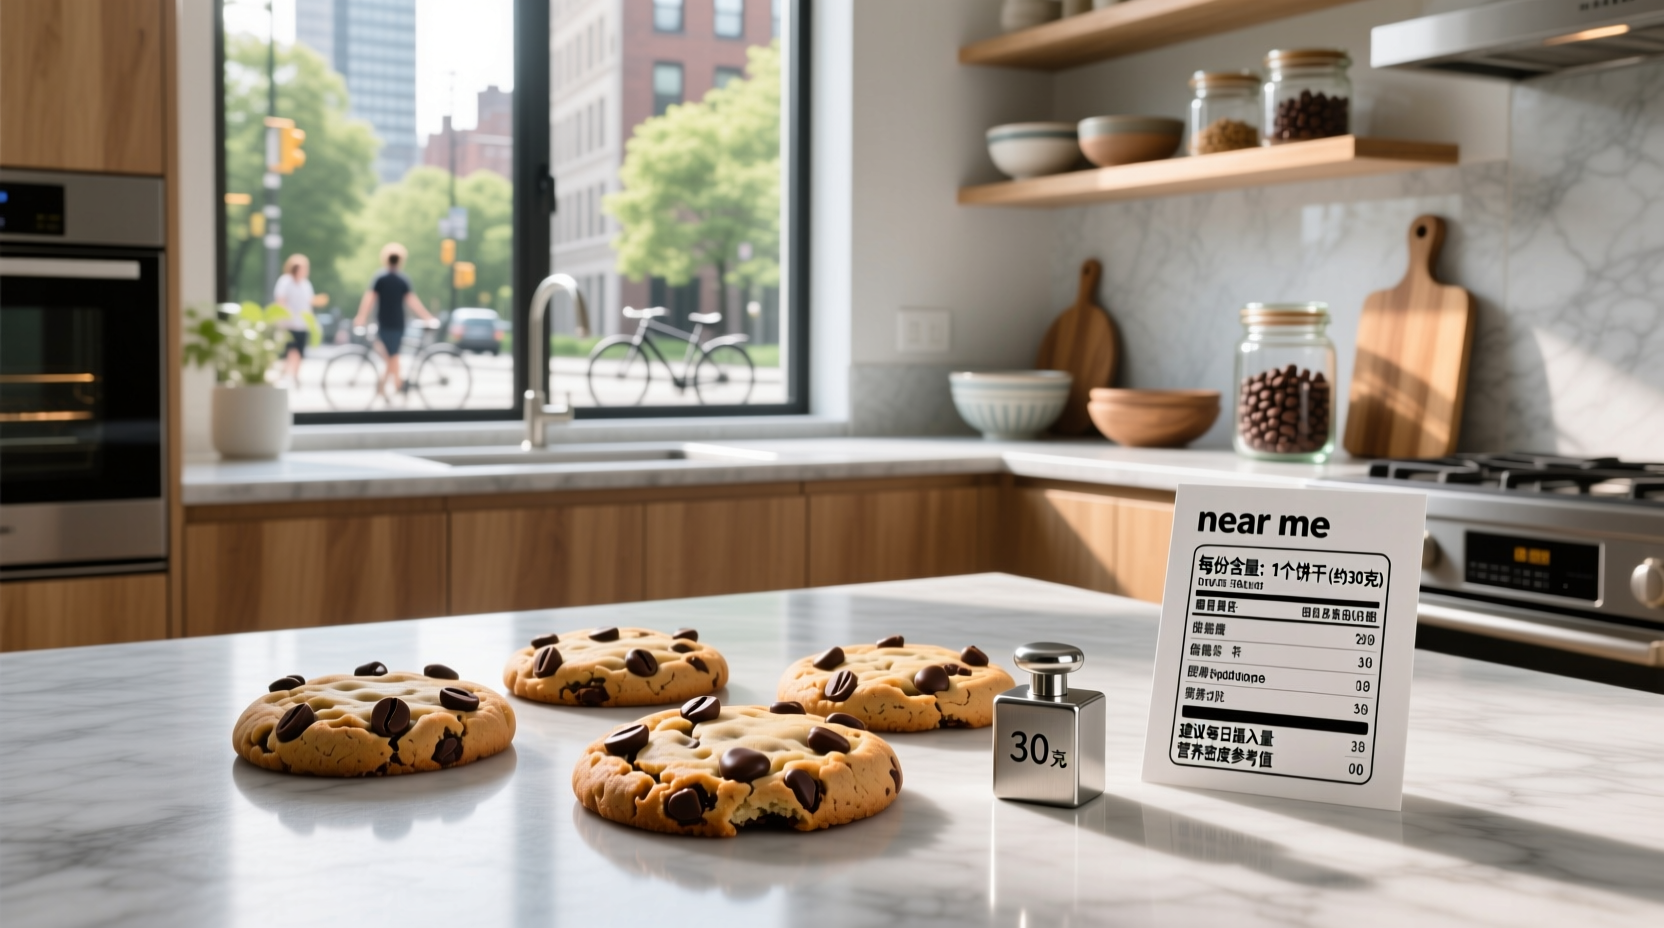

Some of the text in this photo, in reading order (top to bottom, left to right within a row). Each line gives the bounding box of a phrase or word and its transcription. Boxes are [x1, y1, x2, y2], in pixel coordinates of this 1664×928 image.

[1197, 510, 1331, 538] near me
[1010, 731, 1068, 769] 30克
[1348, 763, 1364, 775] 00
